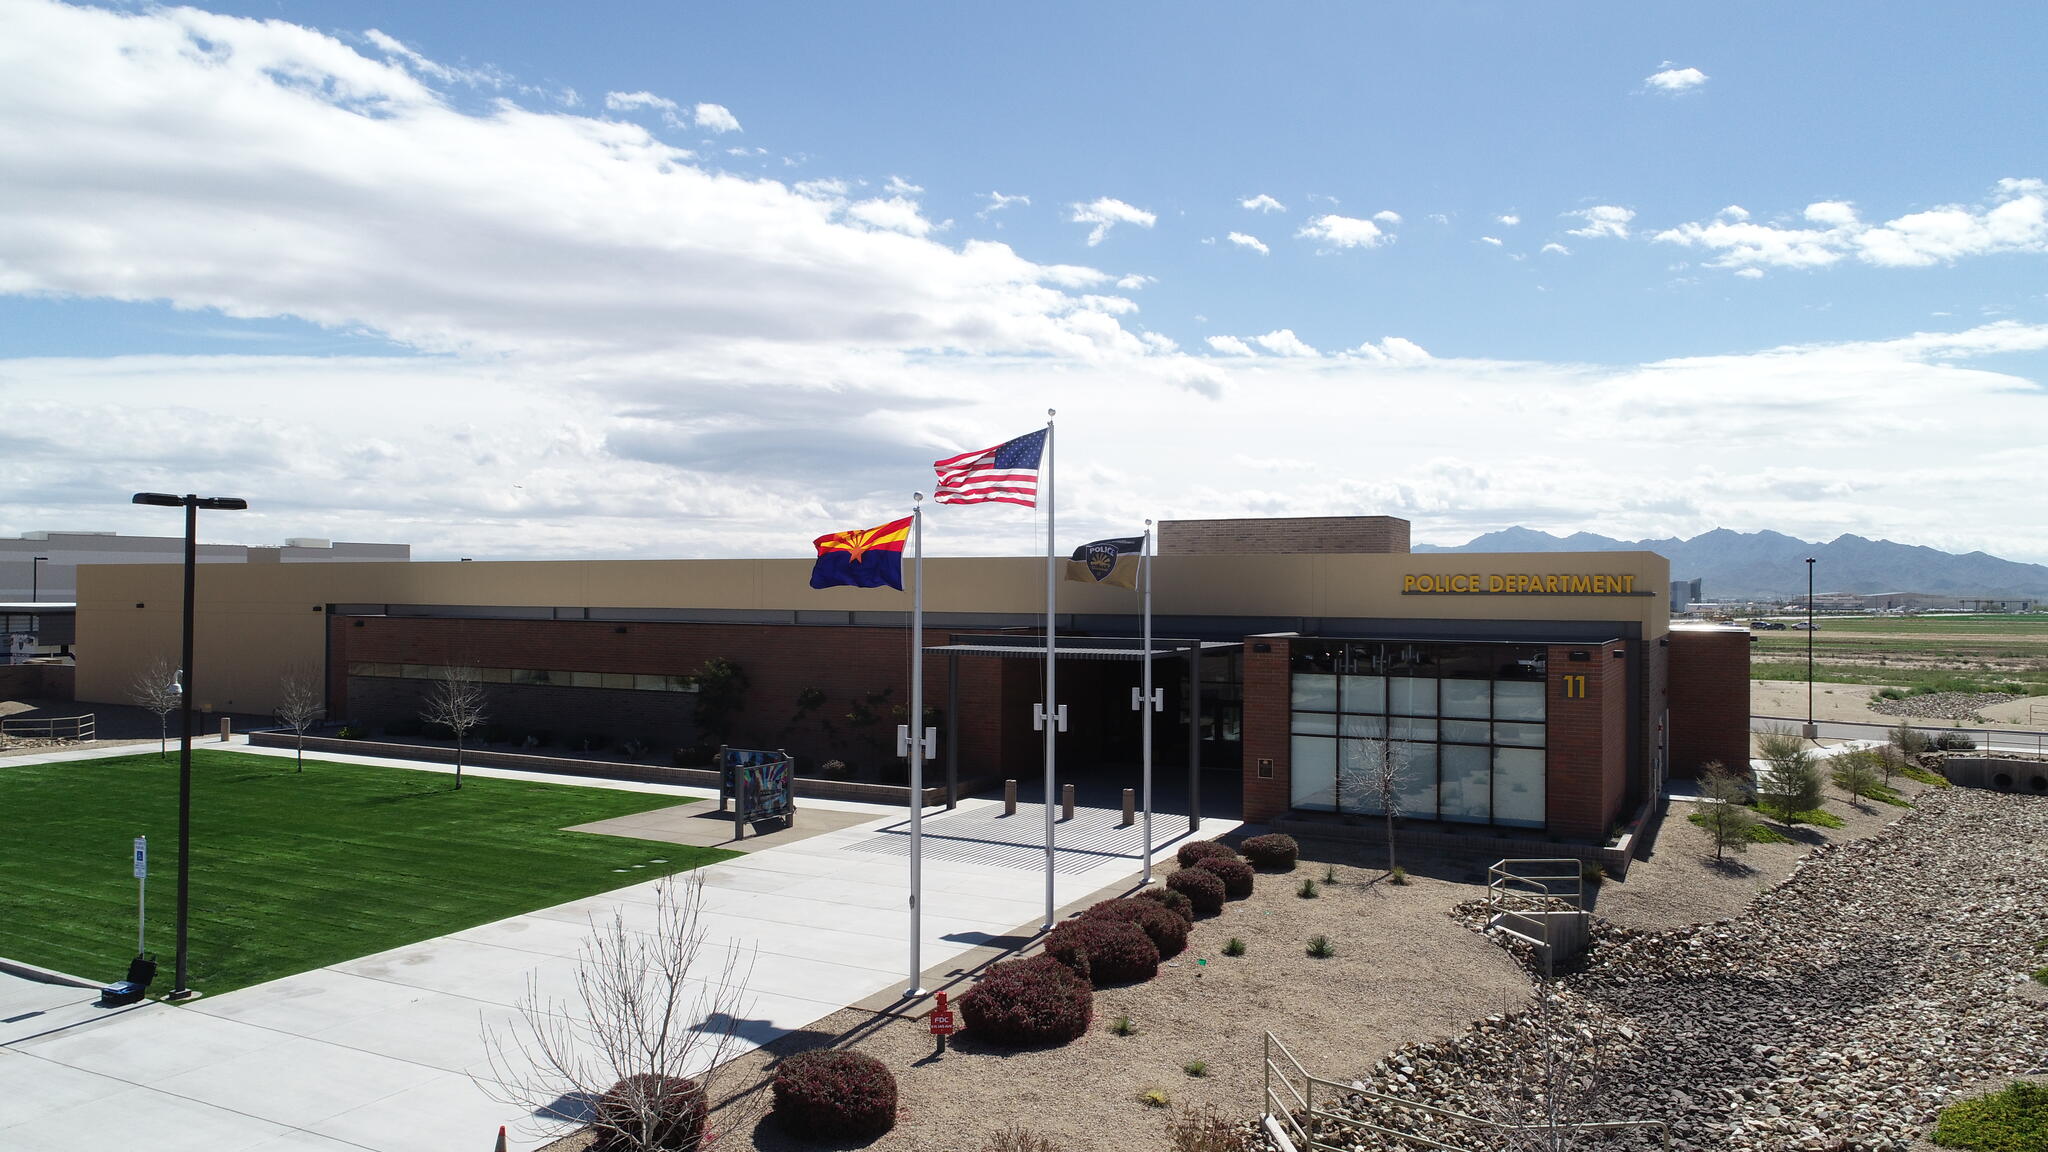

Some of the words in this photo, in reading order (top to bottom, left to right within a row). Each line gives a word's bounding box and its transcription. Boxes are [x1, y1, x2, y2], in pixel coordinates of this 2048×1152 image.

[1089, 546, 1115, 556] POLICE
[1404, 575, 1480, 592] POLICE
[1489, 575, 1634, 593] DEPARTMENT
[1563, 675, 1585, 697] 11
